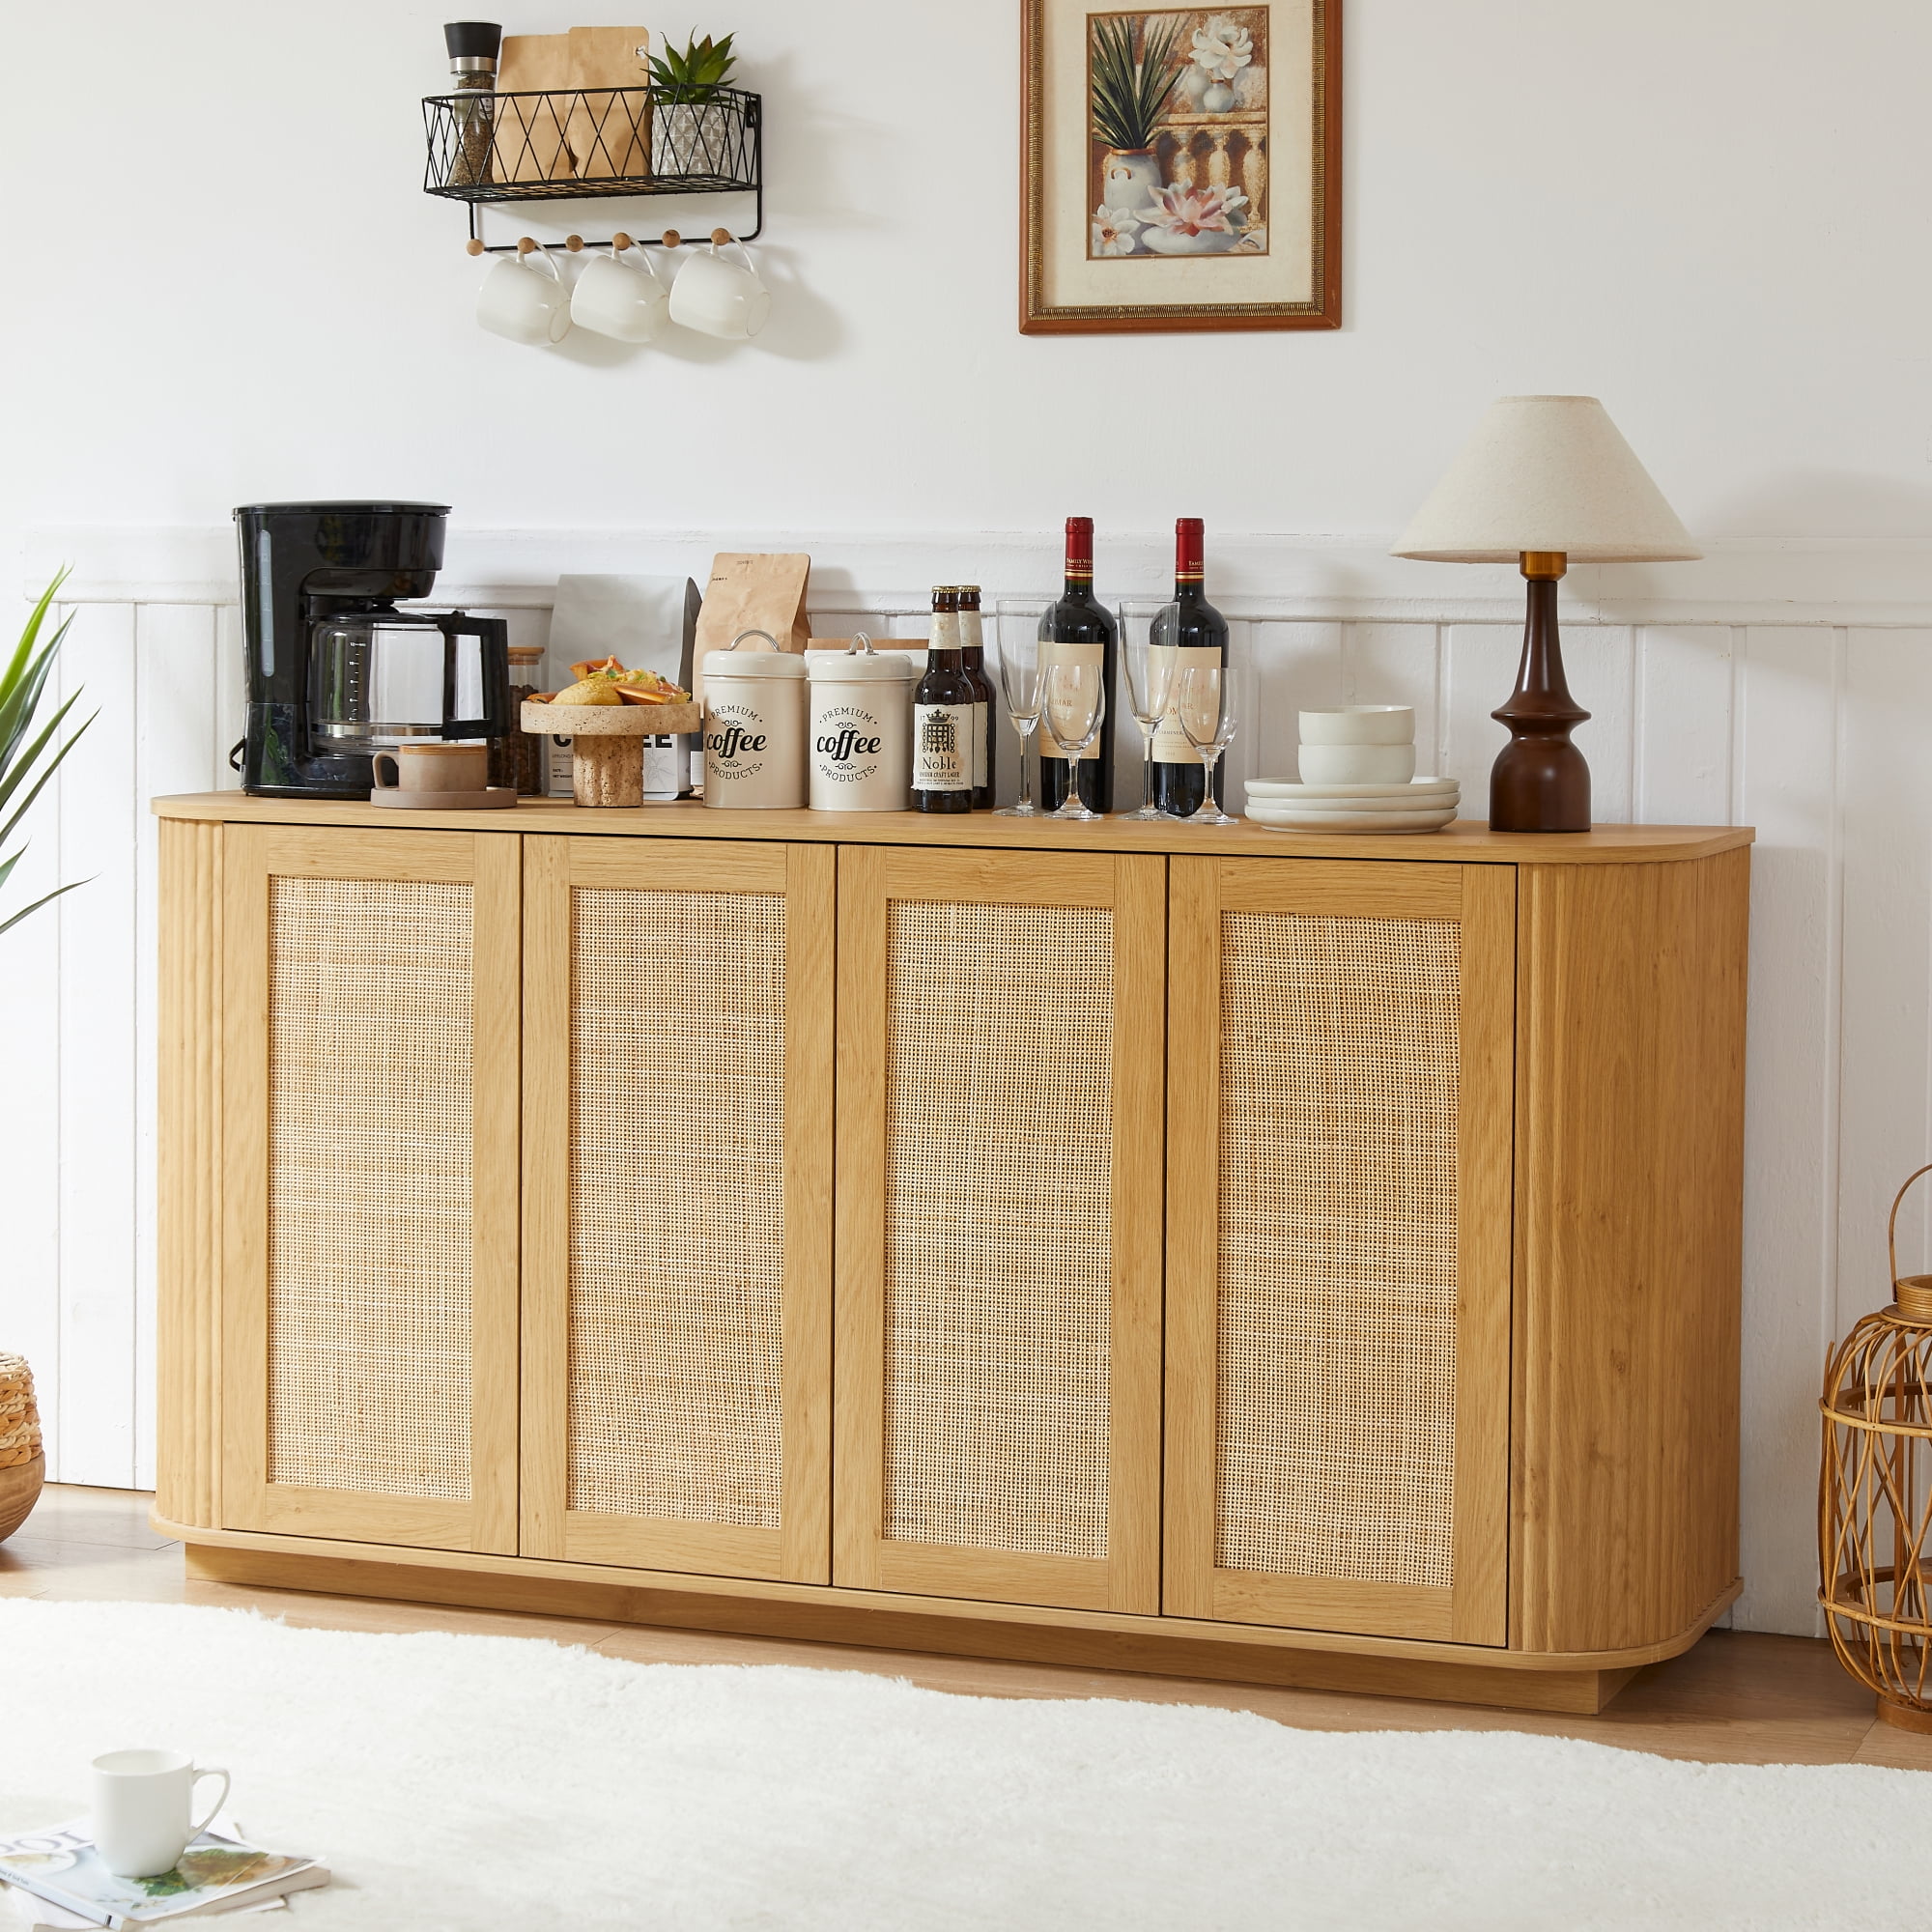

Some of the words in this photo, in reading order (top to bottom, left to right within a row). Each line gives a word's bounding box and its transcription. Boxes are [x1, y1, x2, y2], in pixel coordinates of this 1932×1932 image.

[710, 704, 758, 721] PREMIUM
[822, 707, 874, 723] PREMIUM
[706, 726, 768, 759] coffee
[816, 729, 883, 761] coffee
[710, 761, 761, 781] PRODUCTS
[922, 755, 956, 770] Noble
[820, 764, 876, 782] PRODUCTS
